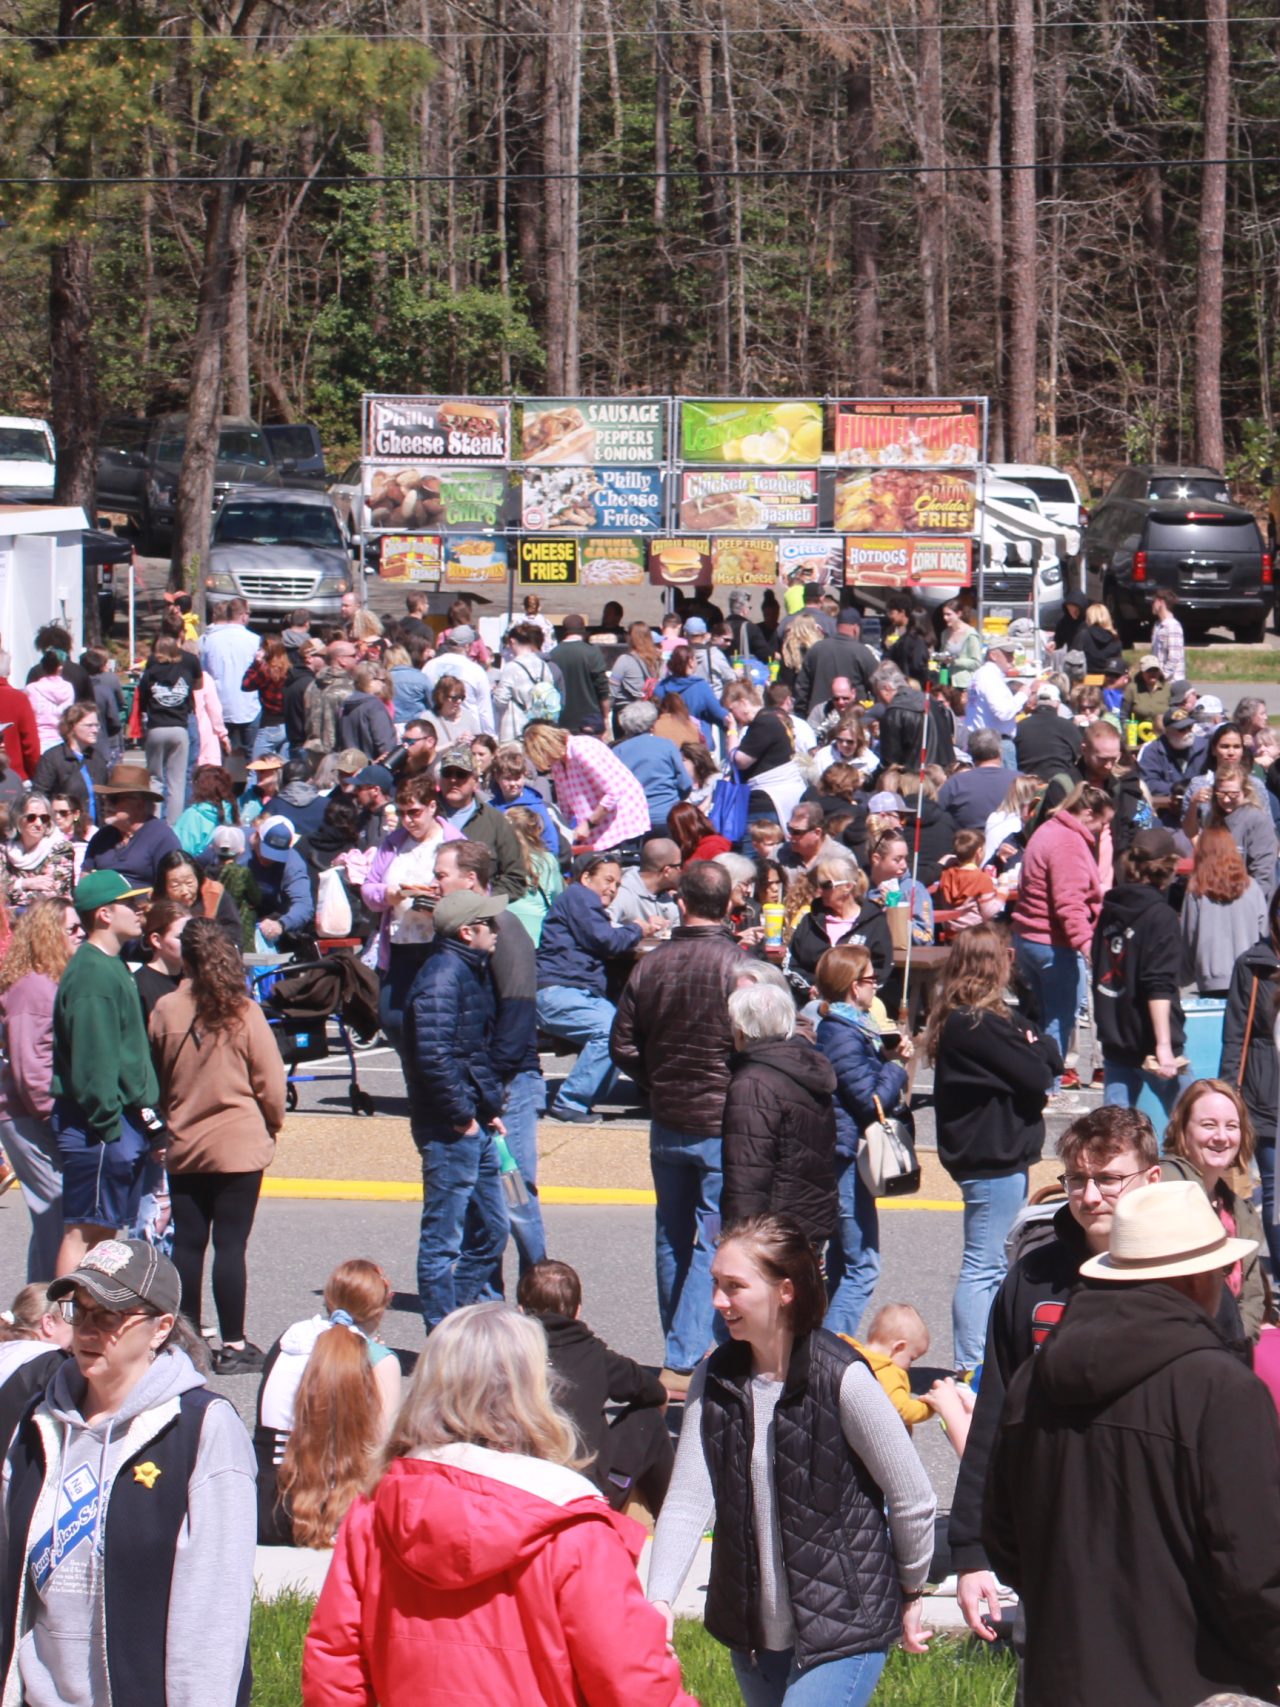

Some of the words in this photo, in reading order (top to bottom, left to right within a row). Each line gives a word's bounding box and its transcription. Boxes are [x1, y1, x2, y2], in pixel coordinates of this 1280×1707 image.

[377, 406, 434, 429] Philly
[588, 404, 660, 423] SAUSAGE
[595, 430, 654, 445] PEPPERS
[839, 413, 910, 449] FUNNEL
[914, 414, 977, 449] CAKES
[376, 430, 444, 454] Cheese
[448, 431, 504, 455] Steak
[602, 471, 652, 492] Philly
[686, 475, 748, 496] Chicken
[752, 474, 813, 499] Tenders
[439, 482, 504, 506] PICKLE
[594, 489, 659, 507] Cheese
[932, 484, 969, 499] BACON
[914, 495, 972, 512] Cheddar
[446, 502, 497, 525] CHIPS
[602, 509, 650, 527] Fries
[761, 508, 812, 522] Basket
[918, 512, 969, 528] FRIES
[522, 543, 575, 561] CHEESE
[744, 540, 774, 551] FRIED
[850, 548, 907, 566] HOTDOGS
[911, 552, 938, 572] CORN
[940, 552, 968, 573] DOGS
[530, 562, 568, 580] FRIES
